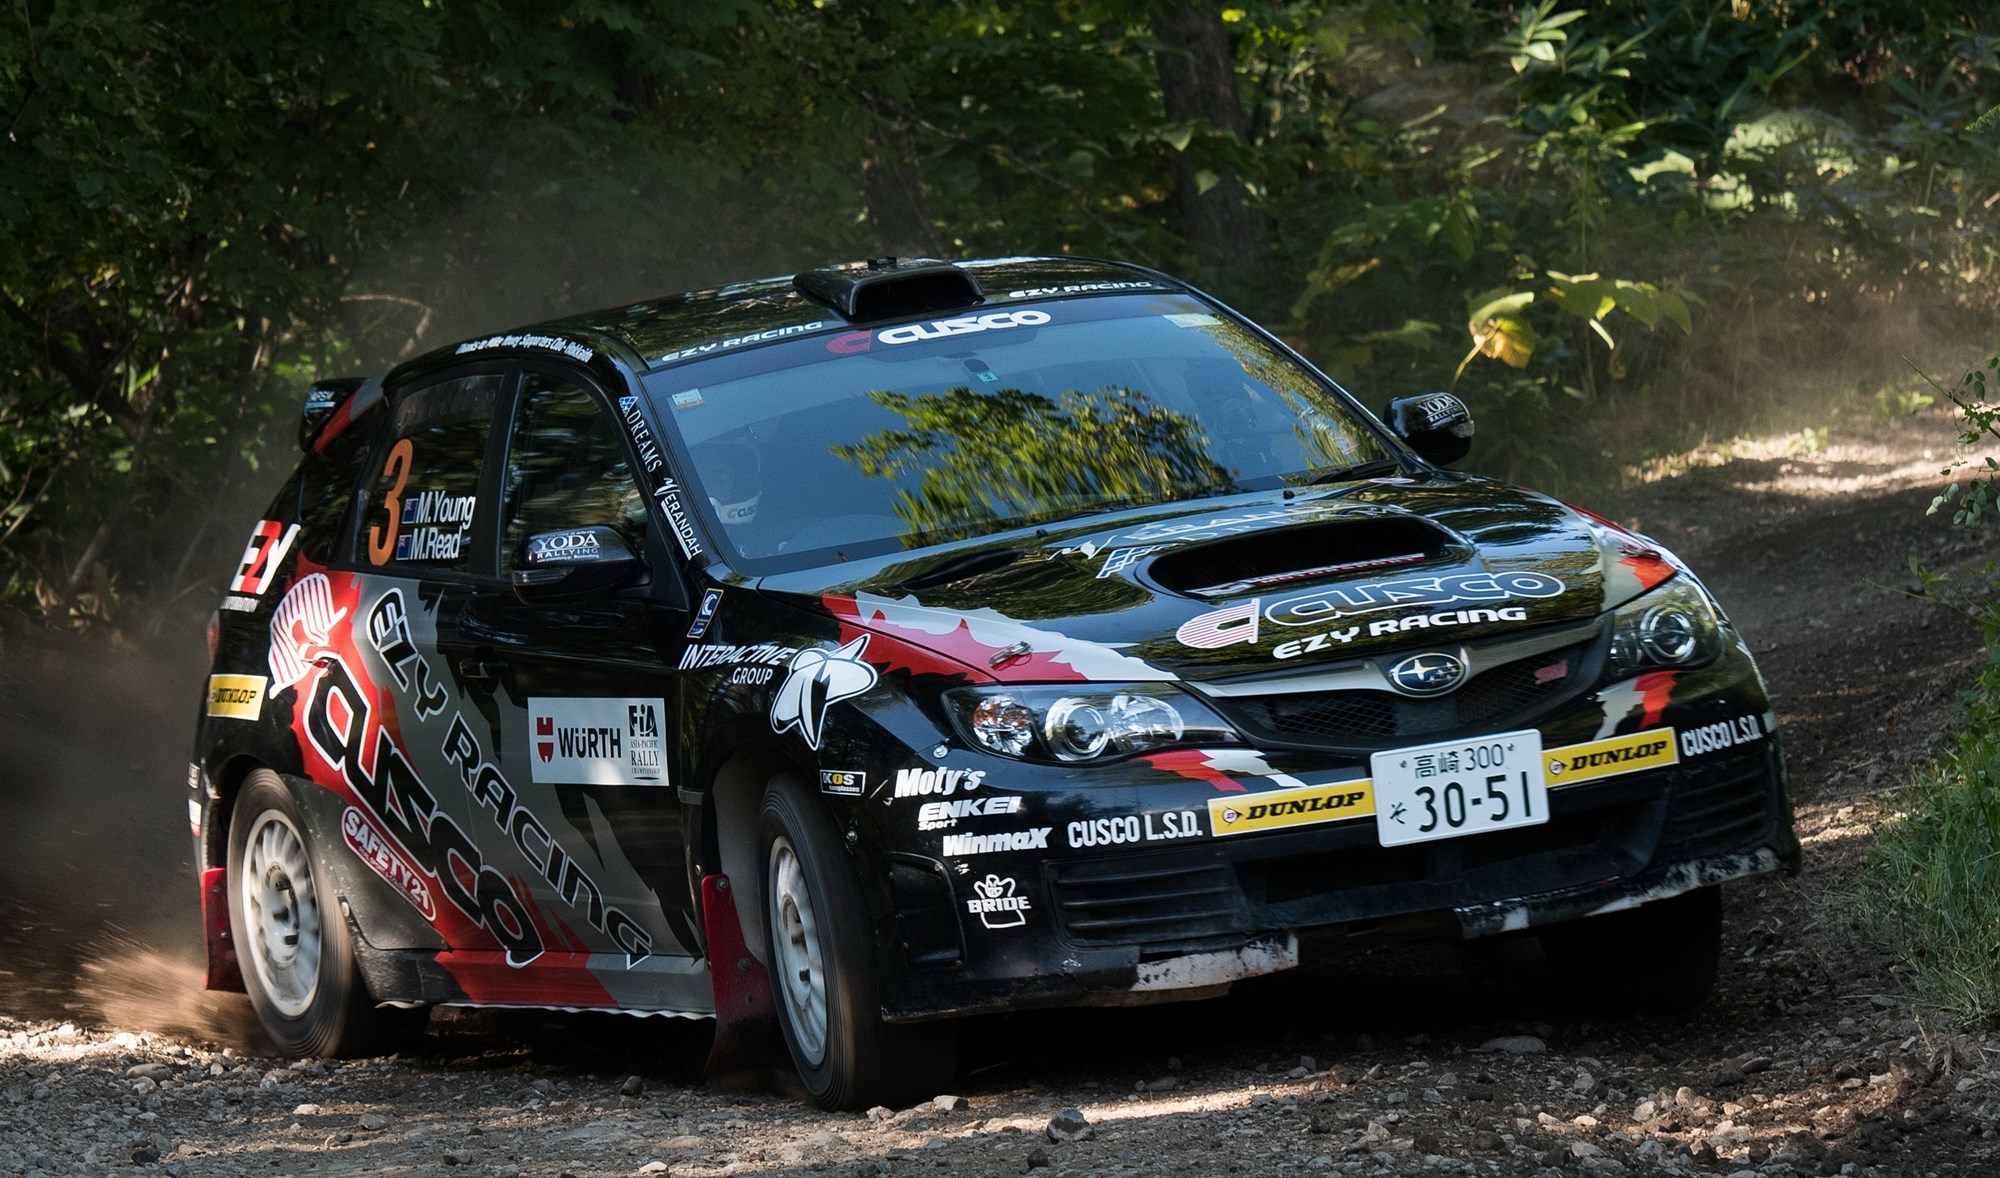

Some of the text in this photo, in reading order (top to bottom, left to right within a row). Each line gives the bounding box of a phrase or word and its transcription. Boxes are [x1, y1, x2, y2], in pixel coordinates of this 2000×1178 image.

[1009, 287, 1059, 298] EZY
[662, 321, 823, 362] EZY RACING
[877, 310, 1051, 346] CUSCO
[1418, 396, 1459, 416] YODA
[626, 410, 662, 472] DREAMS
[369, 438, 413, 566] 3
[416, 490, 476, 530] M.Young
[654, 477, 703, 557] VERANDAH
[230, 520, 301, 595] EZY
[410, 526, 463, 560] M.Read
[537, 533, 600, 552] YODA
[537, 548, 599, 559] RALLYING
[1265, 571, 1566, 627] CUSCO
[1273, 606, 1528, 660] EZY RACING
[366, 587, 448, 722] EZY
[678, 644, 799, 671] INTERACTIVE
[732, 667, 774, 685] GROUP
[216, 688, 257, 704] DUNLOP
[558, 727, 622, 758] WÜRTH
[1680, 721, 1733, 757] CUSCO
[631, 750, 659, 766] RALLY
[1414, 743, 1504, 778] 高崎 300
[1570, 741, 1668, 771] DUNLOP
[822, 773, 855, 785] KOS
[894, 767, 987, 798] Moty's
[918, 796, 1022, 822] ENKEI
[1246, 792, 1364, 820] DUNLOP
[1414, 771, 1531, 832] 30-51
[918, 818, 958, 831] Sport
[1067, 810, 1203, 848] CUSCO L.S.D.
[967, 896, 1032, 913] BRIDE
